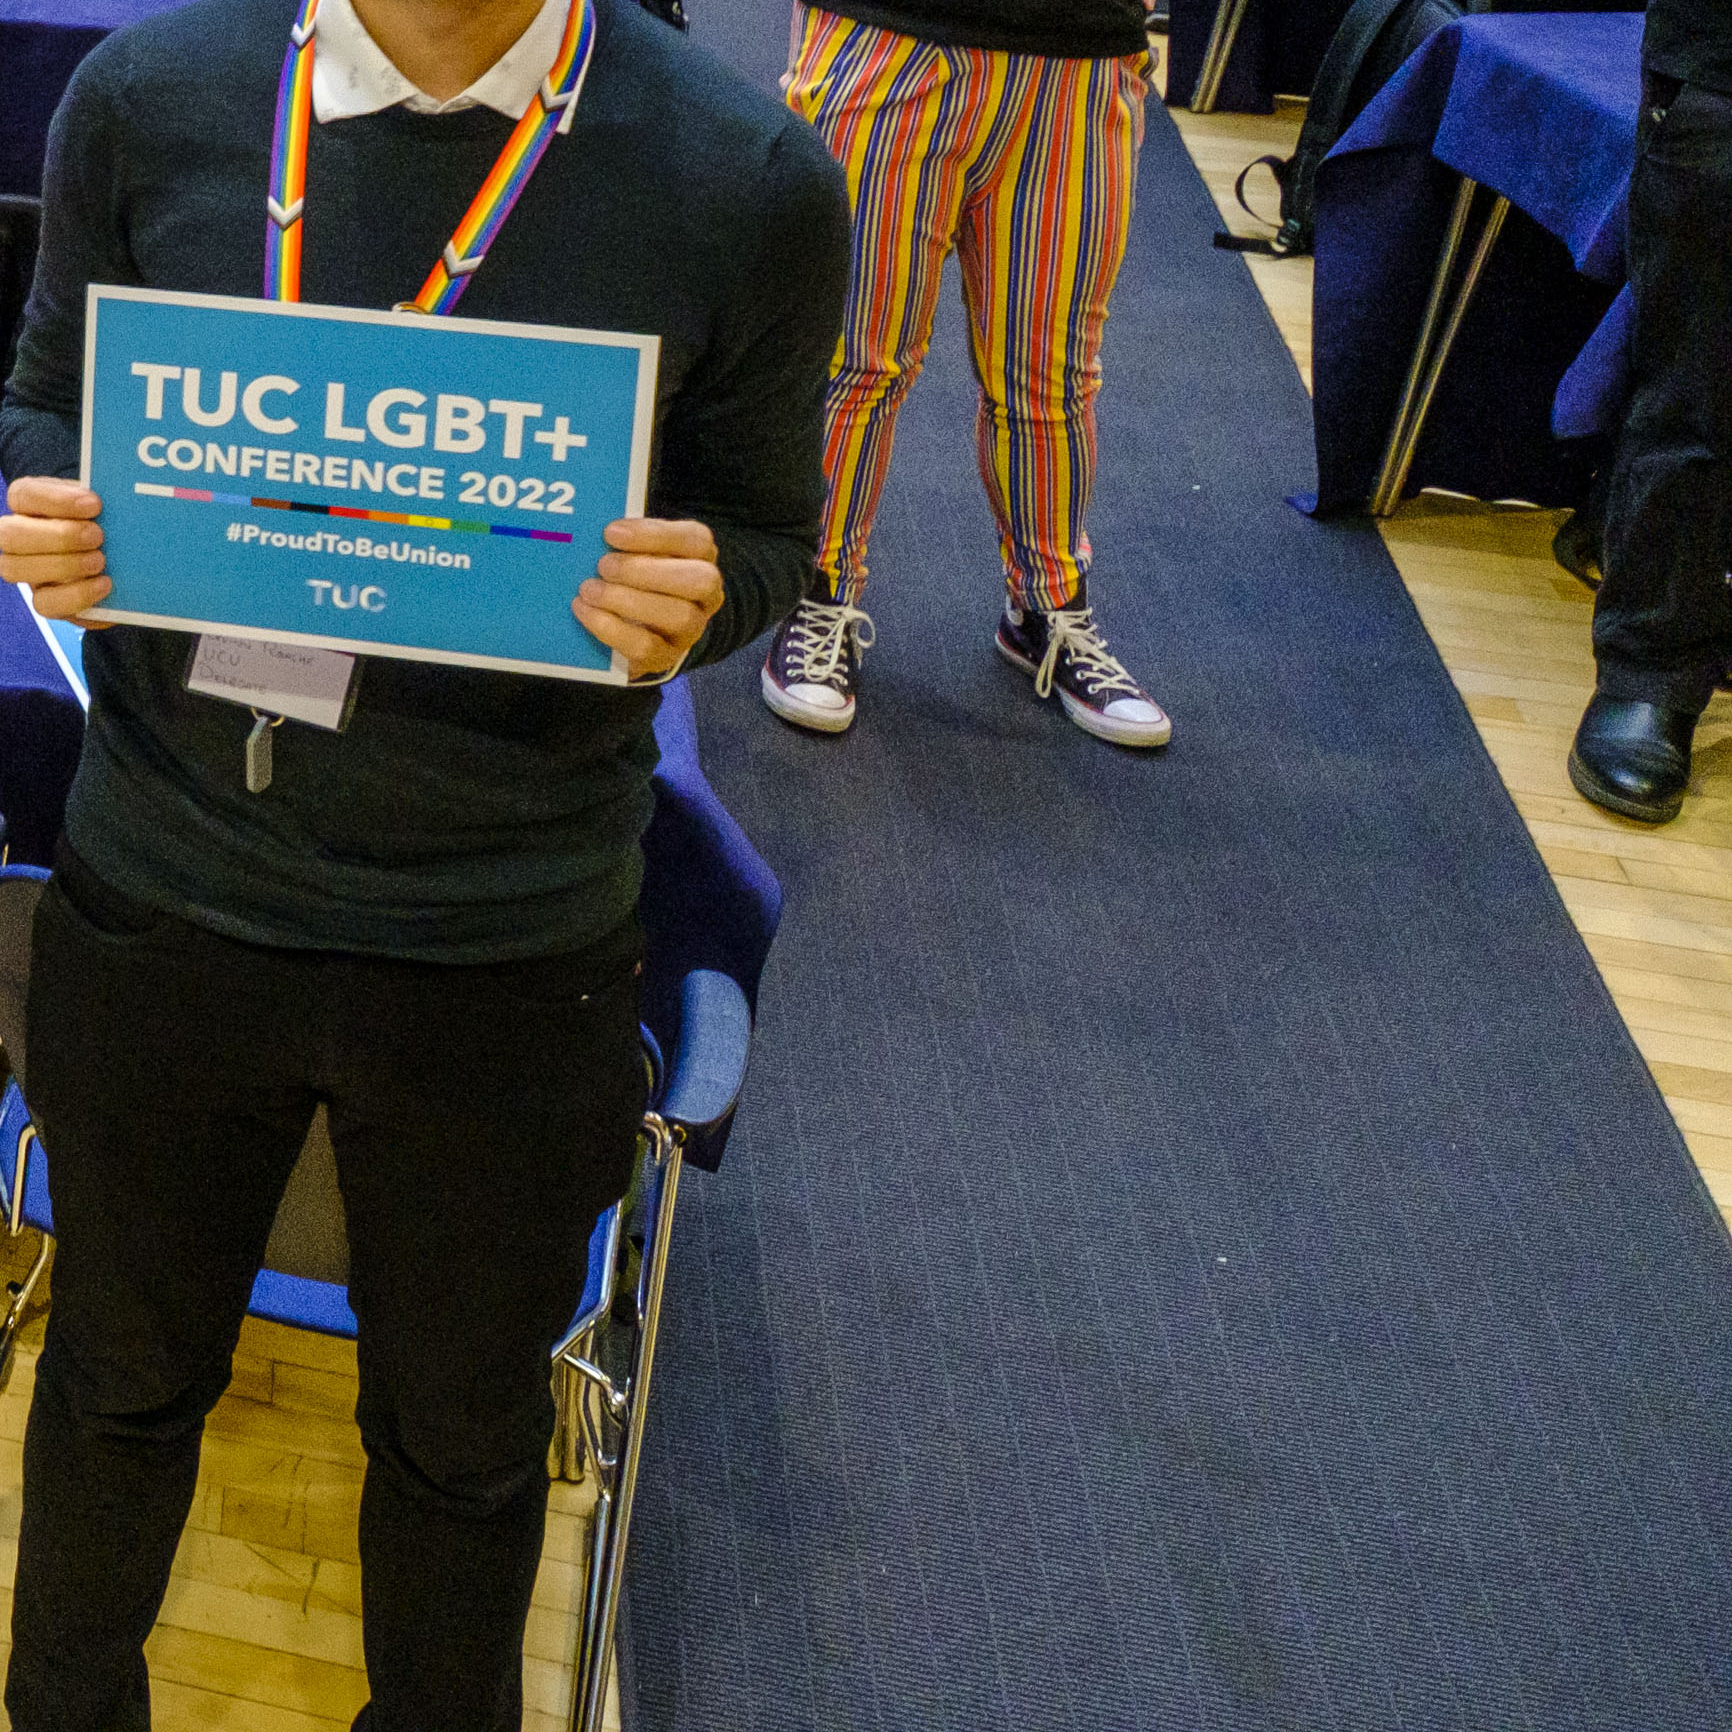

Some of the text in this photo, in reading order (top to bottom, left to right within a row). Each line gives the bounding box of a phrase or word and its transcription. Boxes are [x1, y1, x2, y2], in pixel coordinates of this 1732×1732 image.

[129, 362, 587, 463] TUC LGBT+
[136, 435, 574, 516] CONFERENCE 2022
[226, 522, 469, 571] #ProudToBeUnion
[305, 579, 385, 616] TUC
